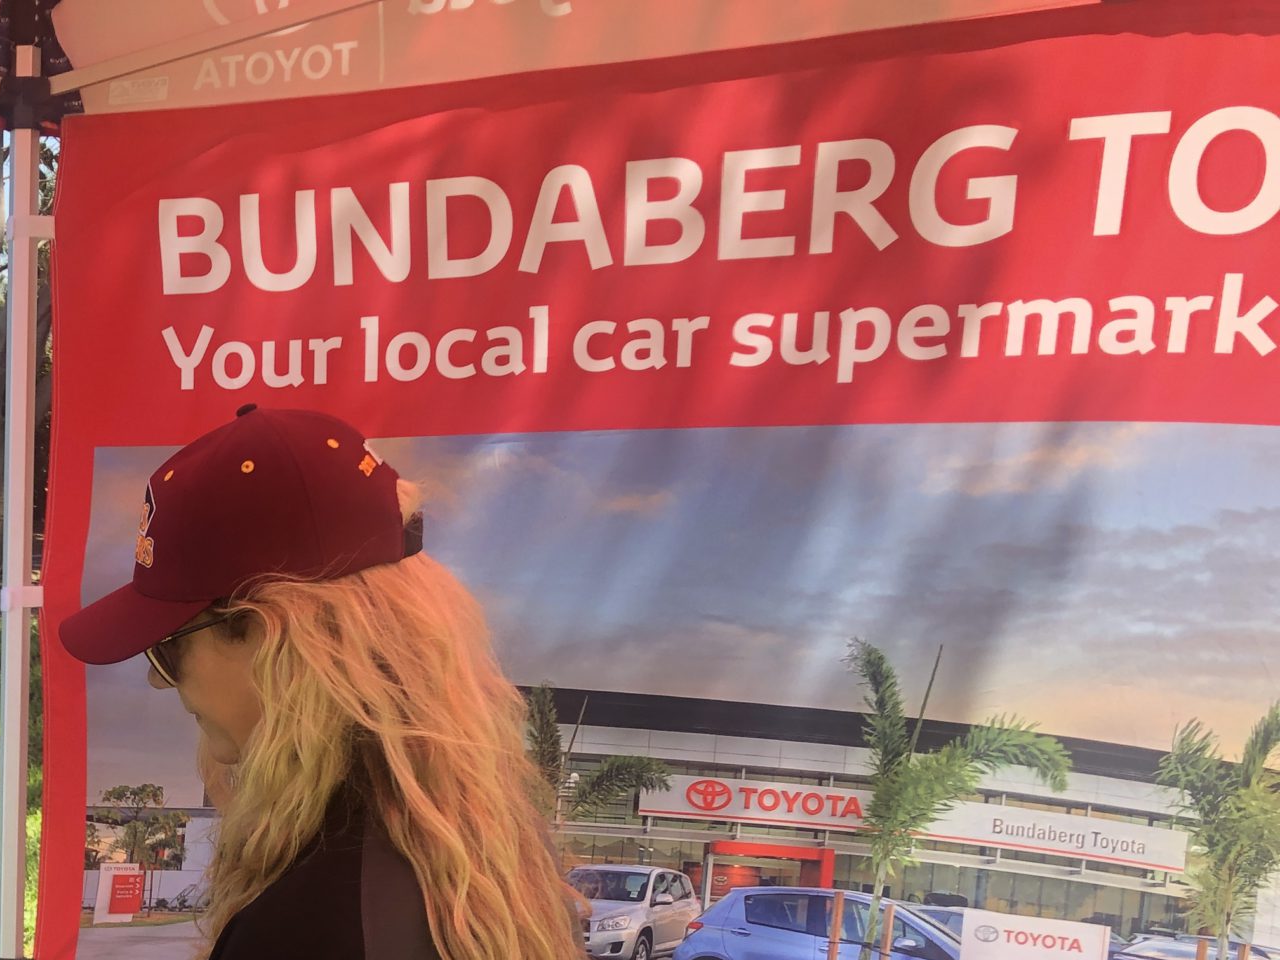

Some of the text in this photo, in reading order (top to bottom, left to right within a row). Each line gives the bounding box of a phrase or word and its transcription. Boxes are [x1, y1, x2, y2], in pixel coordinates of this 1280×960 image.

[158, 105, 1280, 296] BUNDABERG TO
[162, 273, 1280, 391] Your local car supermark
[738, 777, 863, 818] TOYOTA
[992, 817, 1146, 855] Bundaberg Toyota
[1003, 929, 1083, 953] TOYOTA
